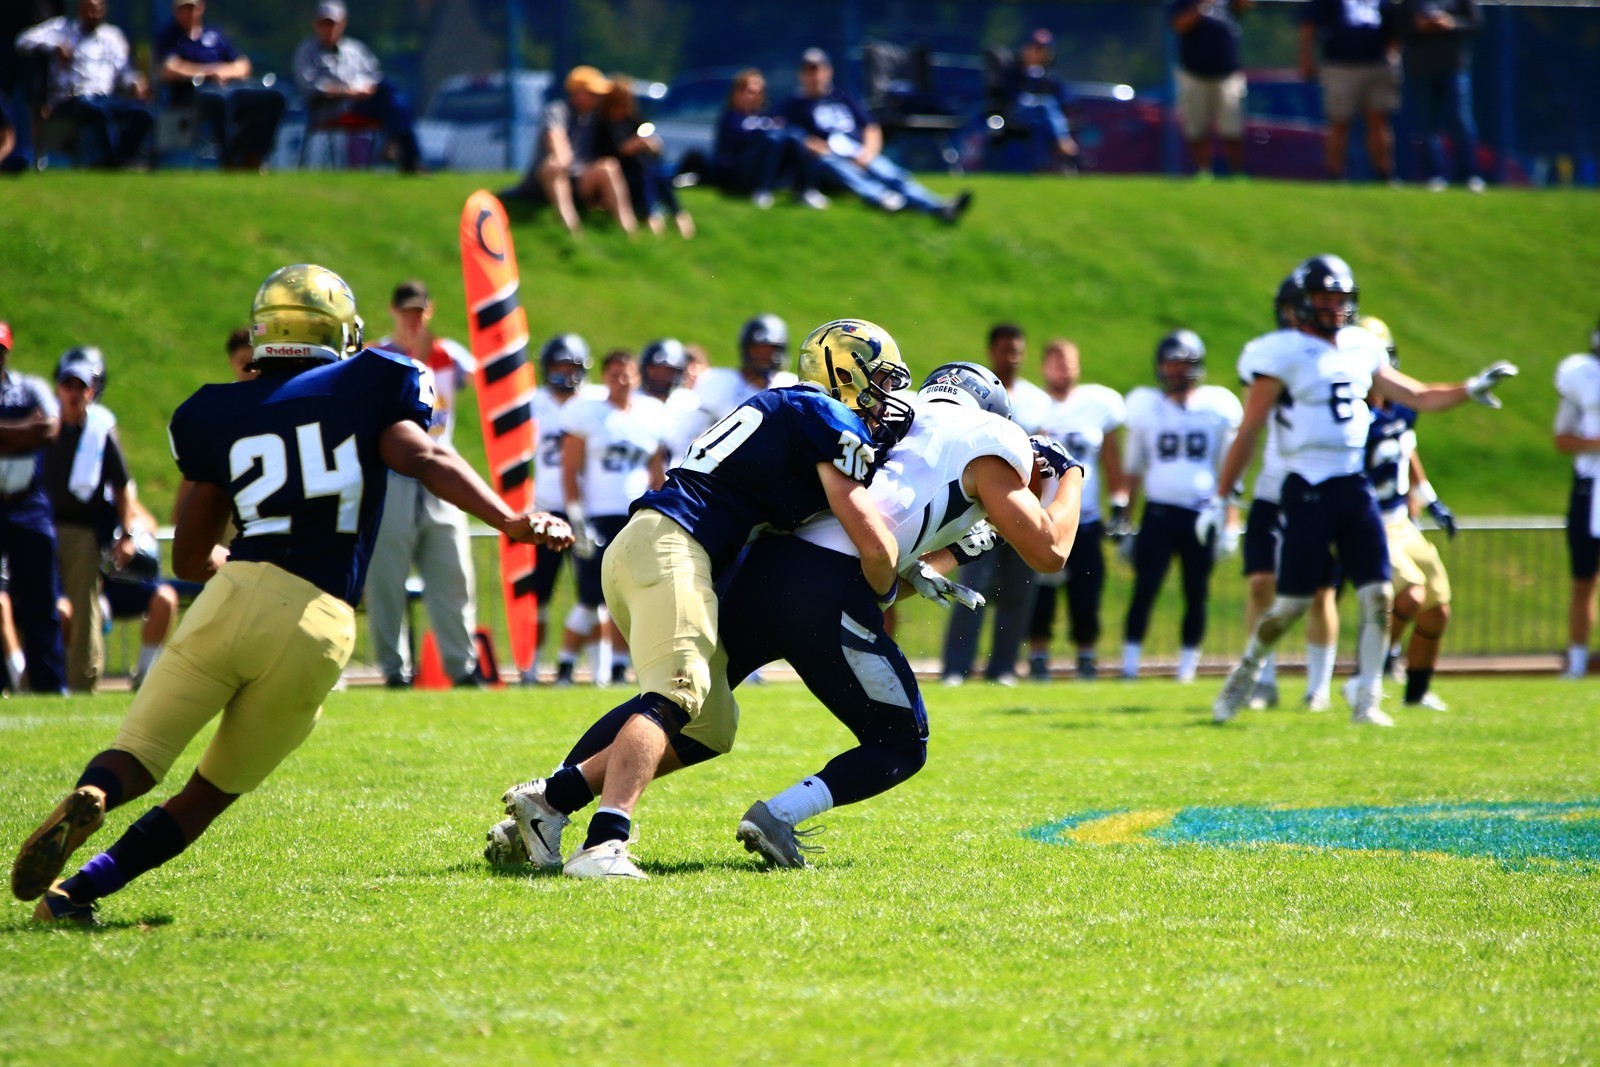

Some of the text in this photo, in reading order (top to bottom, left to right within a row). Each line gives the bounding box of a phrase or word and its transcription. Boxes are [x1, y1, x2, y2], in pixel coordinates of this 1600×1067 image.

[265, 346, 311, 355] Riddell
[926, 385, 958, 395] DIGGERS
[832, 429, 876, 481] 30
[228, 421, 364, 539] 24
